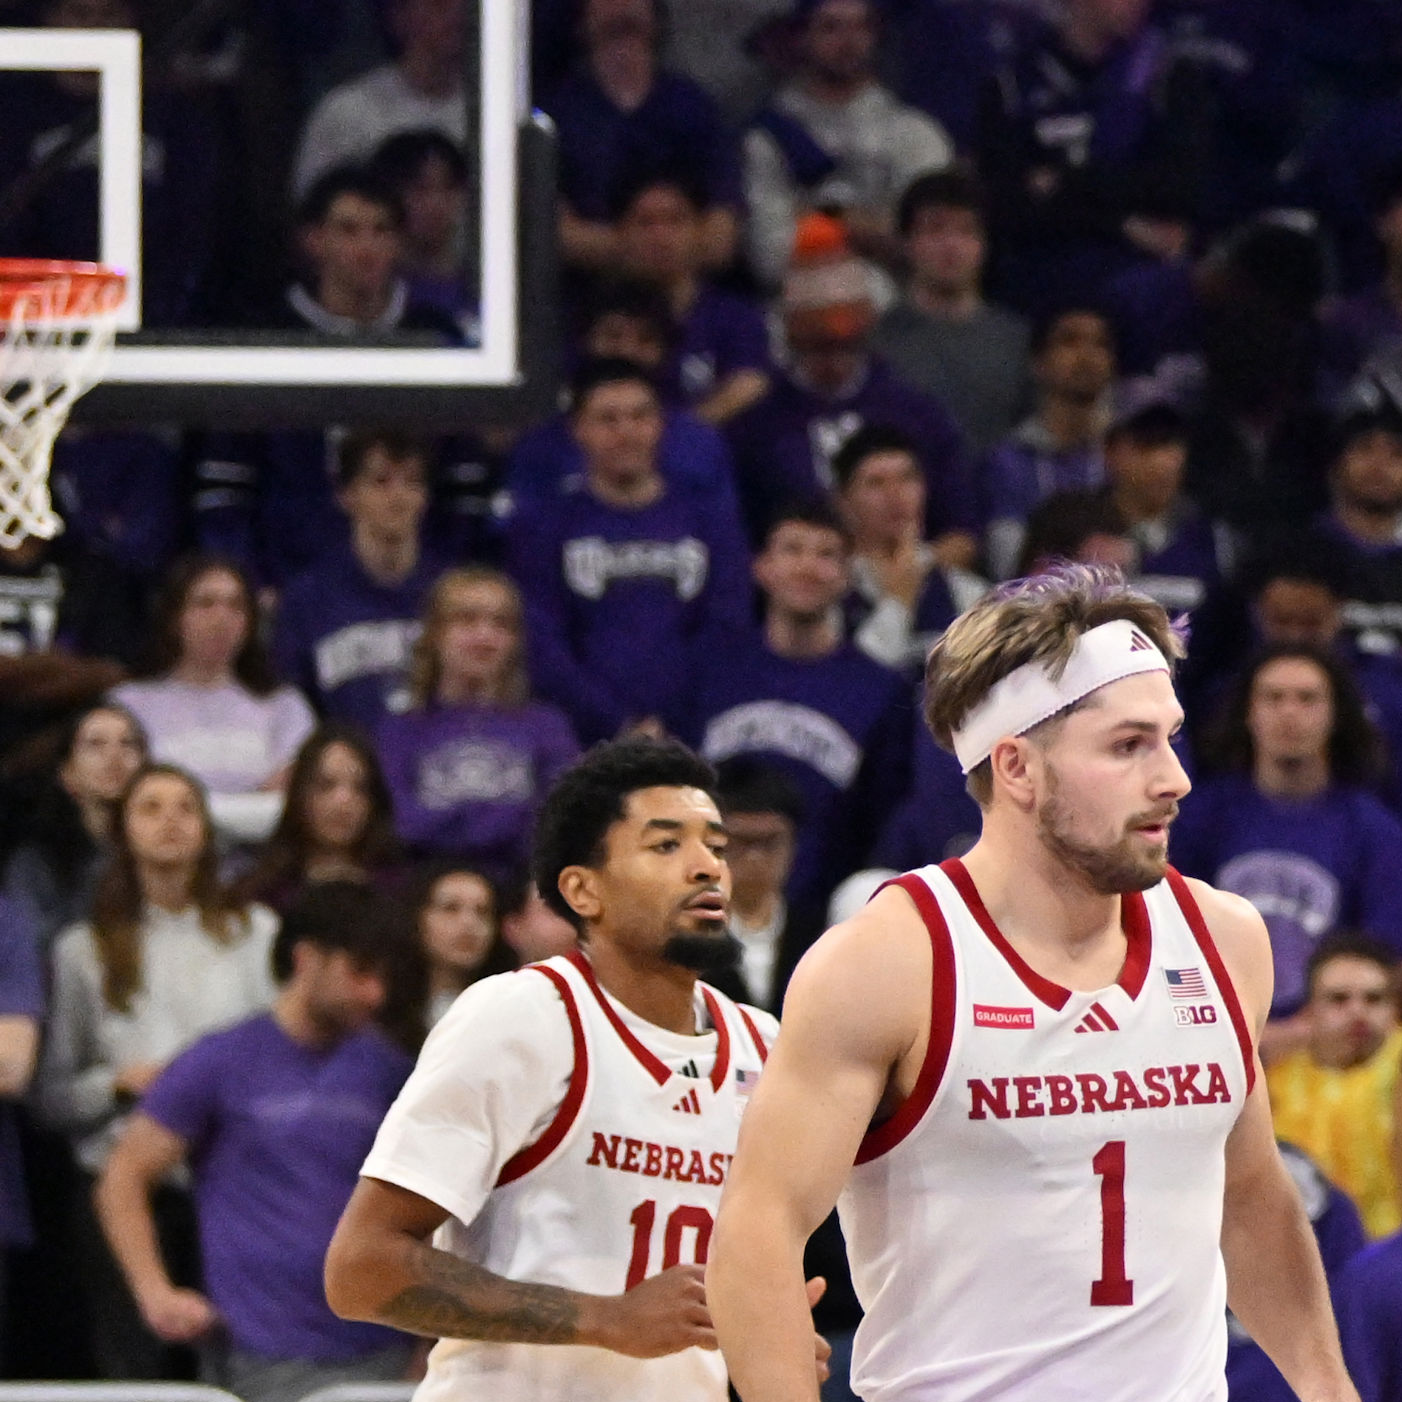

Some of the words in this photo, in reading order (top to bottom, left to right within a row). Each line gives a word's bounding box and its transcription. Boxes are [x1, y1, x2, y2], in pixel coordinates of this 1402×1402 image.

[974, 1010, 1034, 1025] GRADUATE
[967, 1062, 1232, 1121] NEBRASKA
[587, 1131, 734, 1187] NEBRAS
[625, 1199, 715, 1293] 10
[1090, 1140, 1134, 1307] 1
